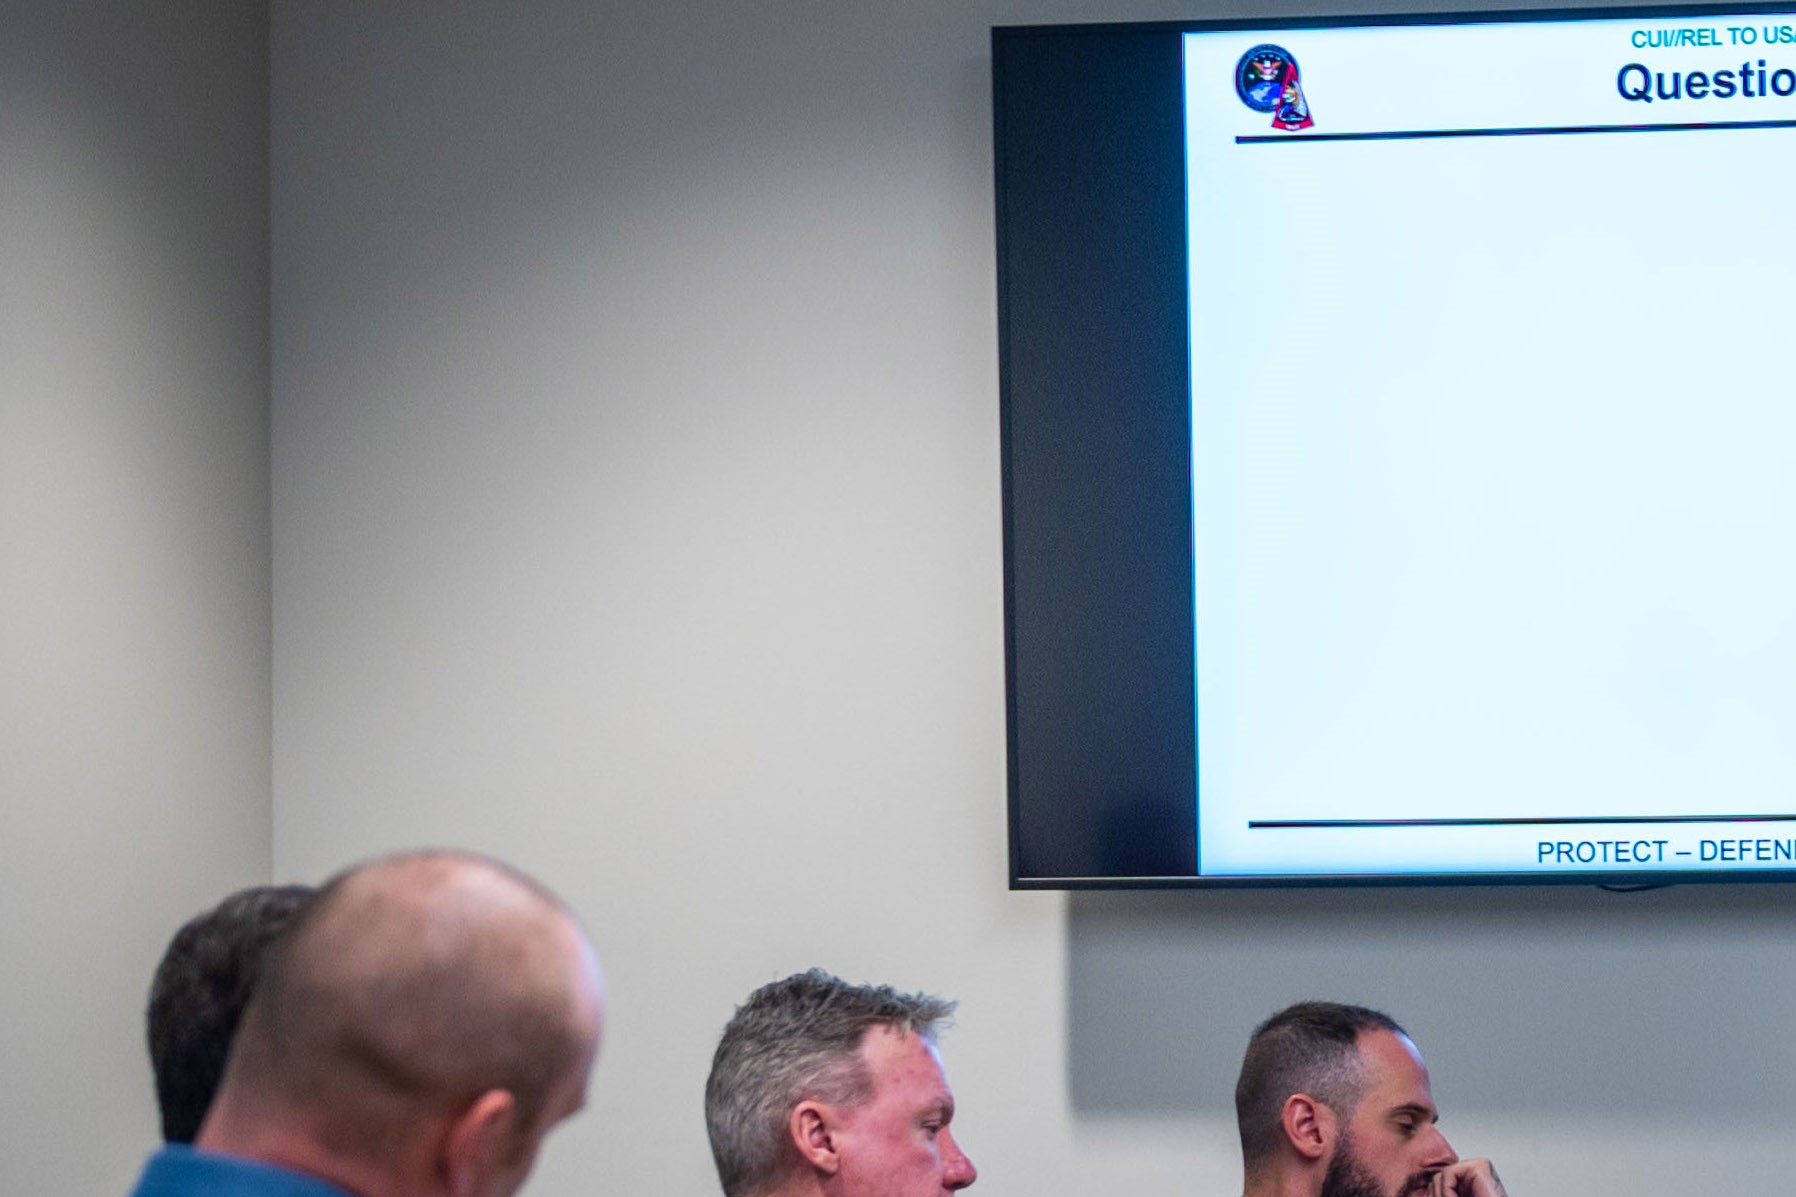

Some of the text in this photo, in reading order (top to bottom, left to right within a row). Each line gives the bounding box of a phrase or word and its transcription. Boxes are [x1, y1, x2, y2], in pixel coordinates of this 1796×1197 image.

[1631, 28, 1722, 48] CUI//REL
[1728, 26, 1757, 45] TO
[1537, 840, 1669, 863] PROTECT
